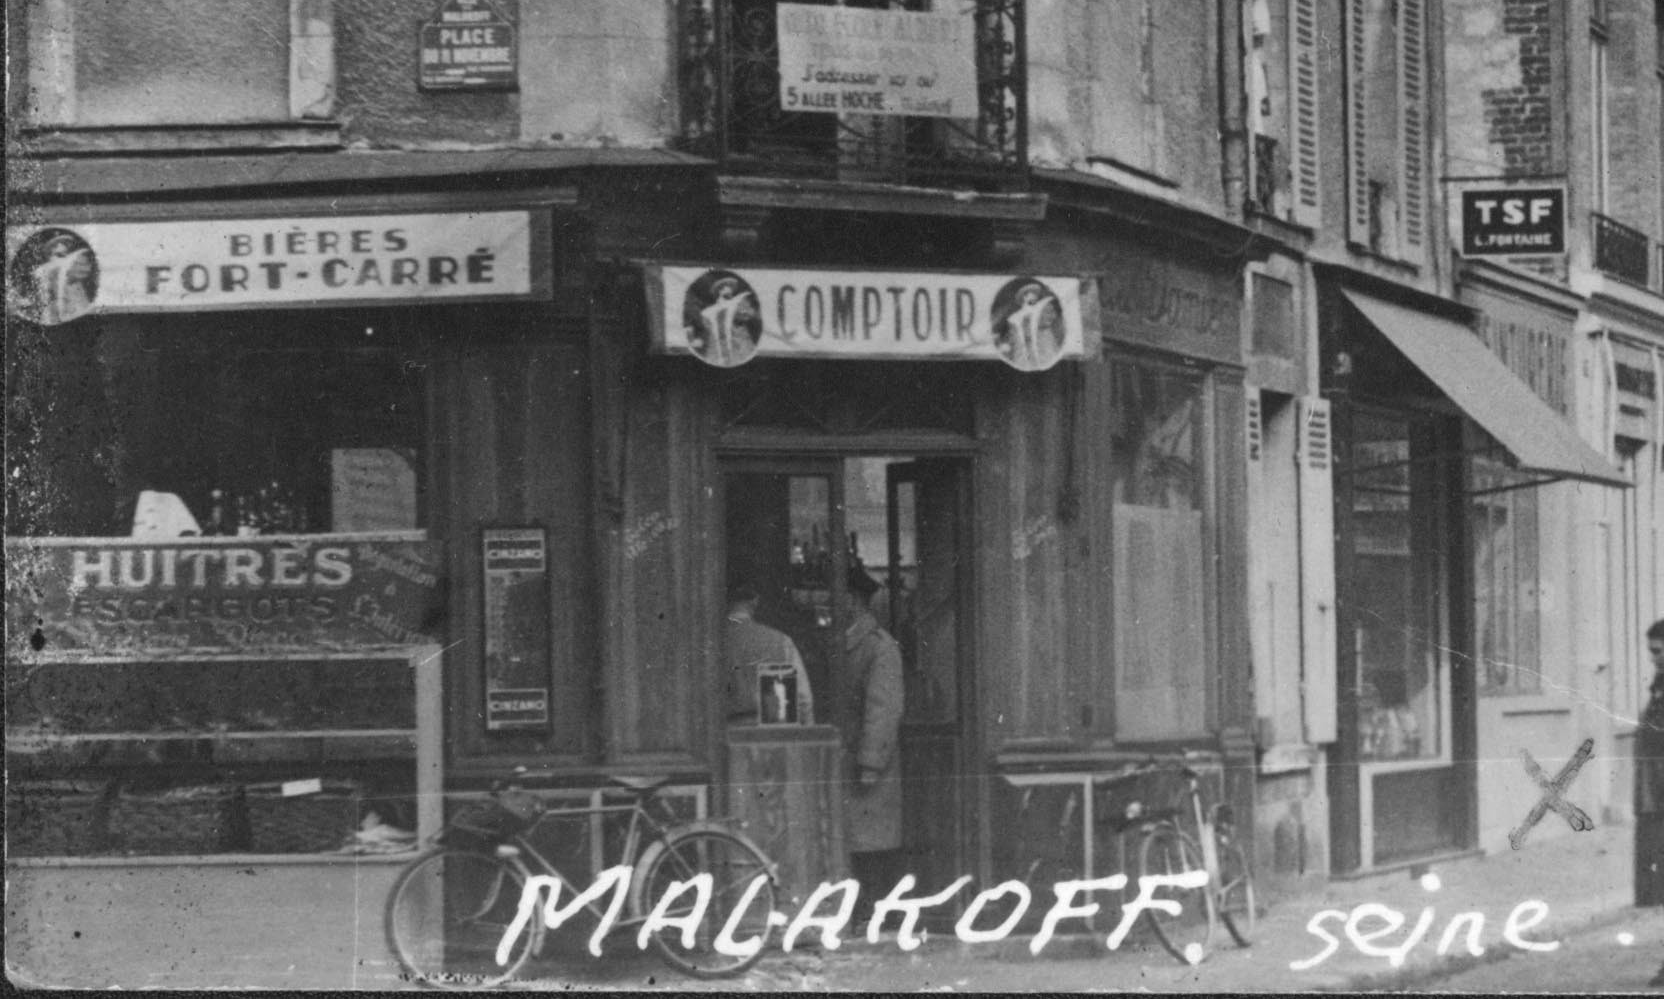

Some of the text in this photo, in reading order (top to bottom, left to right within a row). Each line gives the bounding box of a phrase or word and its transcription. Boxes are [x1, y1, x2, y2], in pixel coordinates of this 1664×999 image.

[440, 28, 496, 45] PLACE
[786, 85, 799, 106] 5
[1474, 198, 1554, 225] TSF
[229, 226, 410, 258] BIÈRES
[145, 246, 496, 295] FORT-CARRÉ
[776, 283, 979, 345] COMPTOIR
[488, 549, 542, 559] CINZANO
[71, 548, 353, 588] HUITRES
[489, 701, 545, 711] CINZANO
